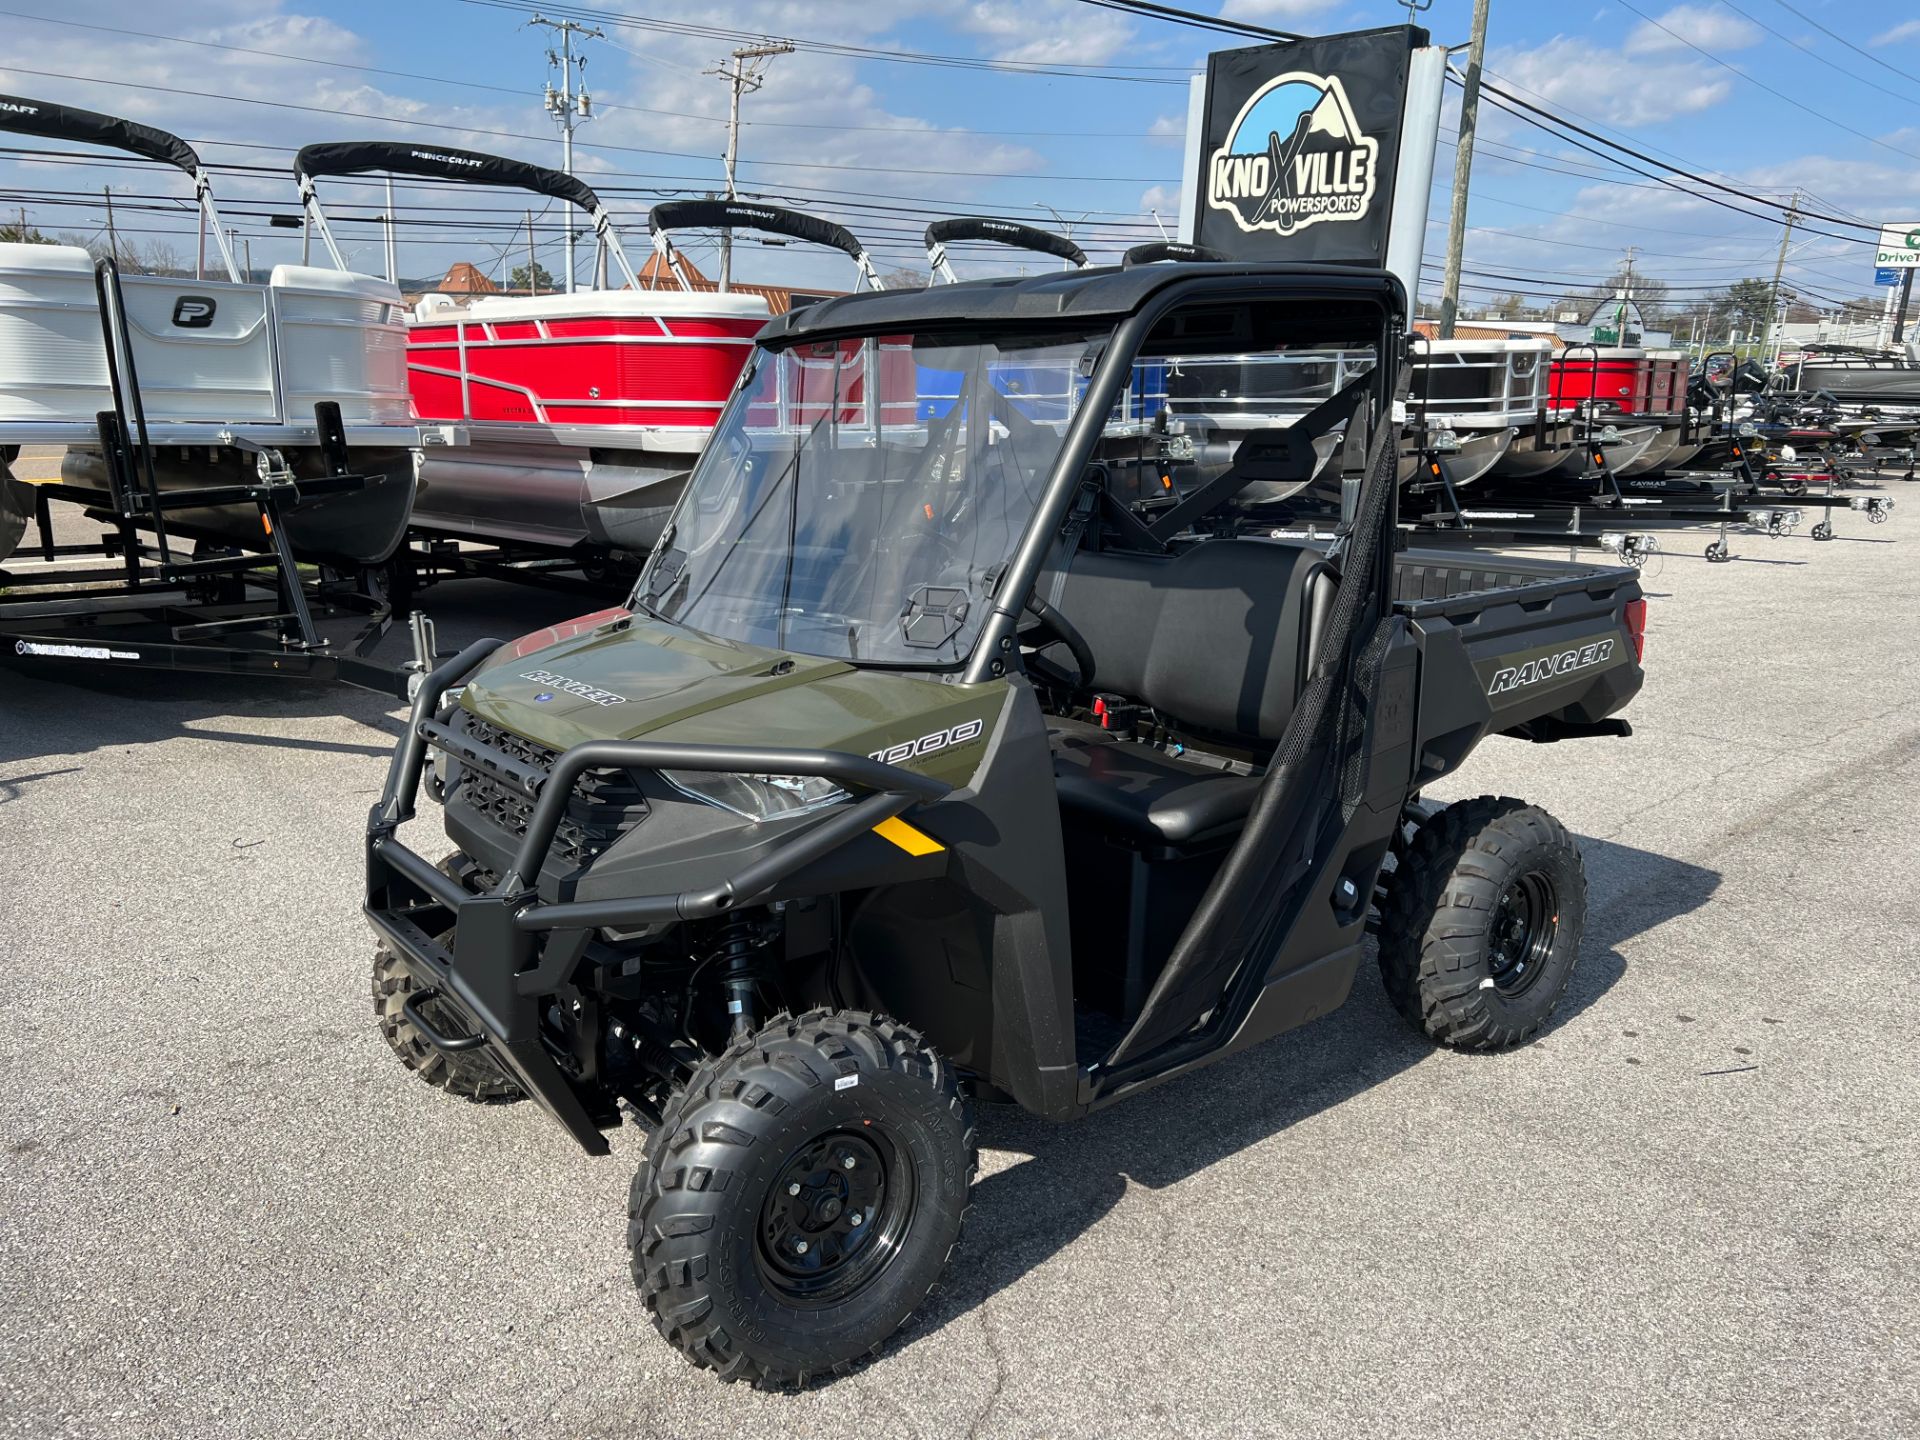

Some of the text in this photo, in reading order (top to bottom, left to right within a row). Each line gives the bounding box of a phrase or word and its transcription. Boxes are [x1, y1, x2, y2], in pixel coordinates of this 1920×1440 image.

[411, 150, 483, 168] PRINCECRAFT
[1214, 149, 1367, 198] KNOXVILLE
[1270, 195, 1361, 214] POWERSPORTS
[1487, 638, 1615, 696] RANGER
[519, 669, 626, 707] RANGER
